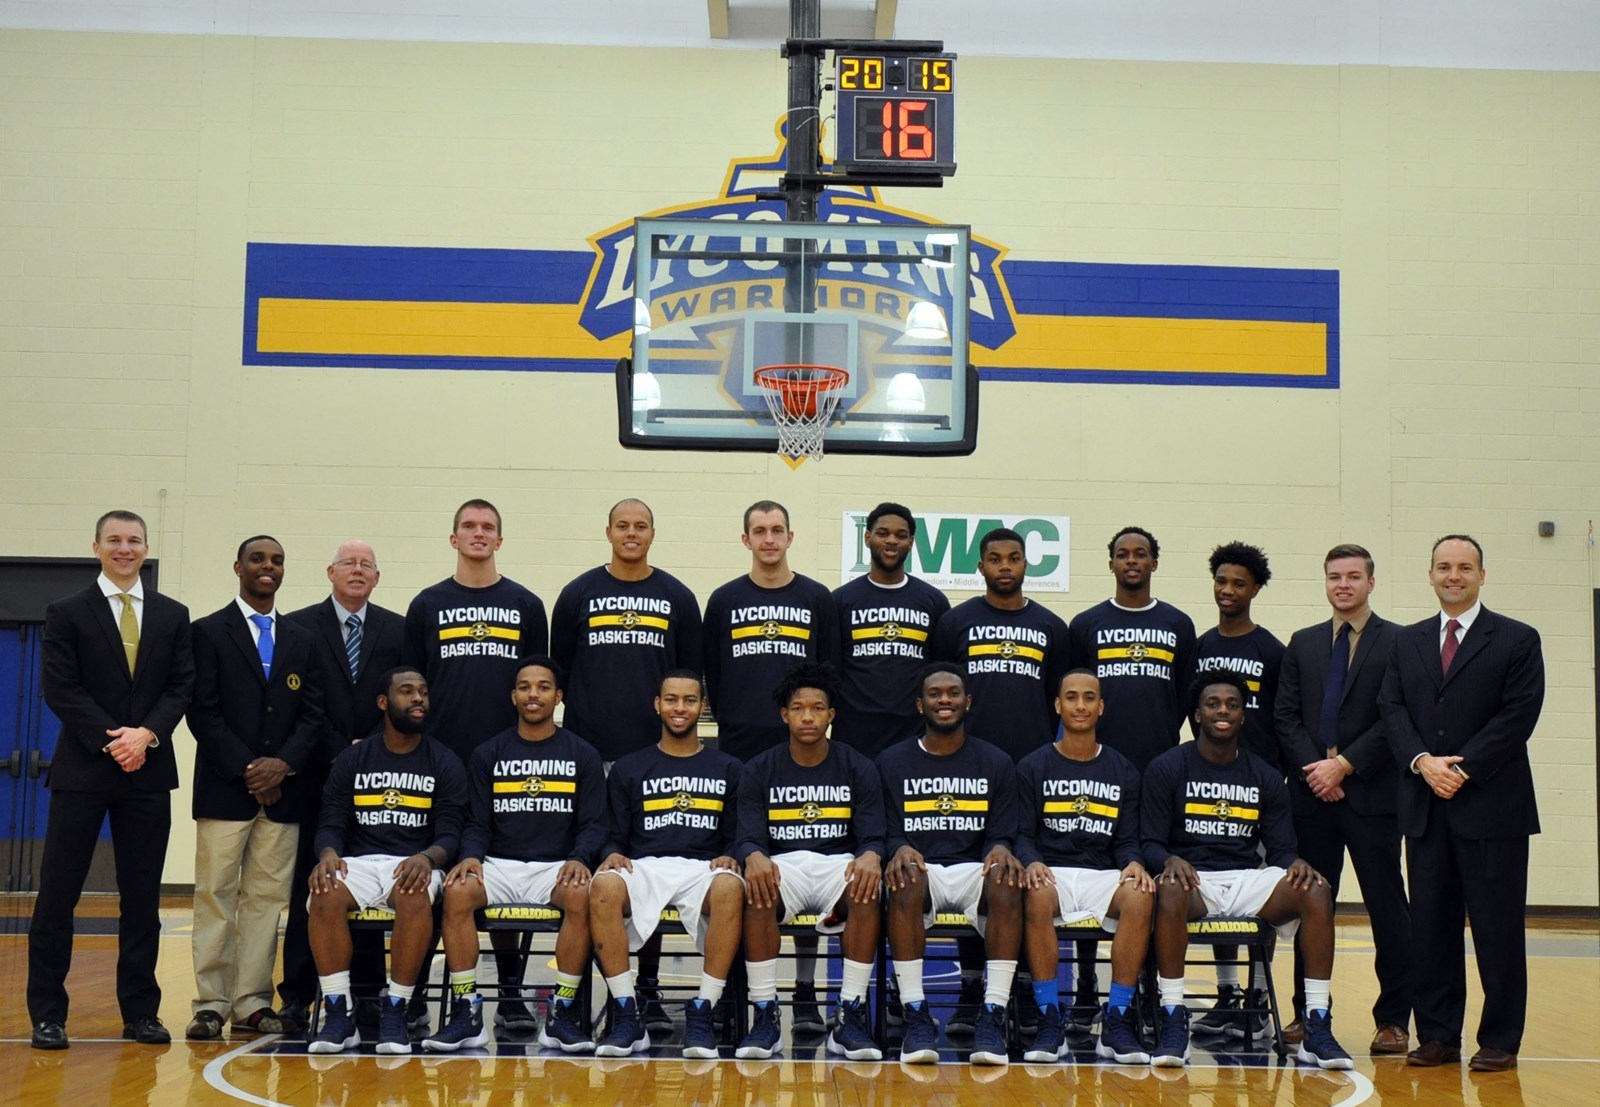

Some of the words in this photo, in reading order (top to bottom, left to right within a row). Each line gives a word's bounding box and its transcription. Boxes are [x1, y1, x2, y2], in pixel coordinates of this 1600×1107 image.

[841, 58, 882, 89] 20
[922, 60, 951, 91] 15
[882, 101, 933, 159] 16
[661, 284, 934, 322] WARIOR
[953, 577, 979, 586] Middle
[1022, 578, 1060, 588] nferences
[589, 596, 671, 615] LYCOMING
[731, 605, 811, 625] LYCOMING
[439, 607, 521, 625] LYCOMING
[851, 607, 930, 627] LYCOMING
[588, 630, 665, 648] BASKETBALL
[968, 625, 1047, 648] LYCOMING
[1097, 628, 1176, 648] LYCOMING
[440, 641, 519, 660] BASKETBALL
[732, 640, 807, 658] BASKETBALL
[852, 641, 924, 660] BASKETBALL
[968, 659, 1041, 680] BASKETBALL
[1097, 662, 1171, 681] BASKETBALL
[1196, 656, 1264, 677] YCOMING
[494, 760, 576, 777] LYCOMING
[354, 771, 436, 793] LYCOMING
[642, 776, 727, 796] LYCOMING
[904, 777, 988, 795] LYCOMING
[1043, 779, 1121, 802] LYCOMING
[769, 785, 851, 804] LYCOMING
[1186, 781, 1260, 803] LYCOMING
[493, 797, 573, 813] BASKETBALL
[904, 816, 985, 832] BASKETBALL
[484, 907, 562, 920] WARRIORS
[1186, 921, 1259, 934] WARRIORS
